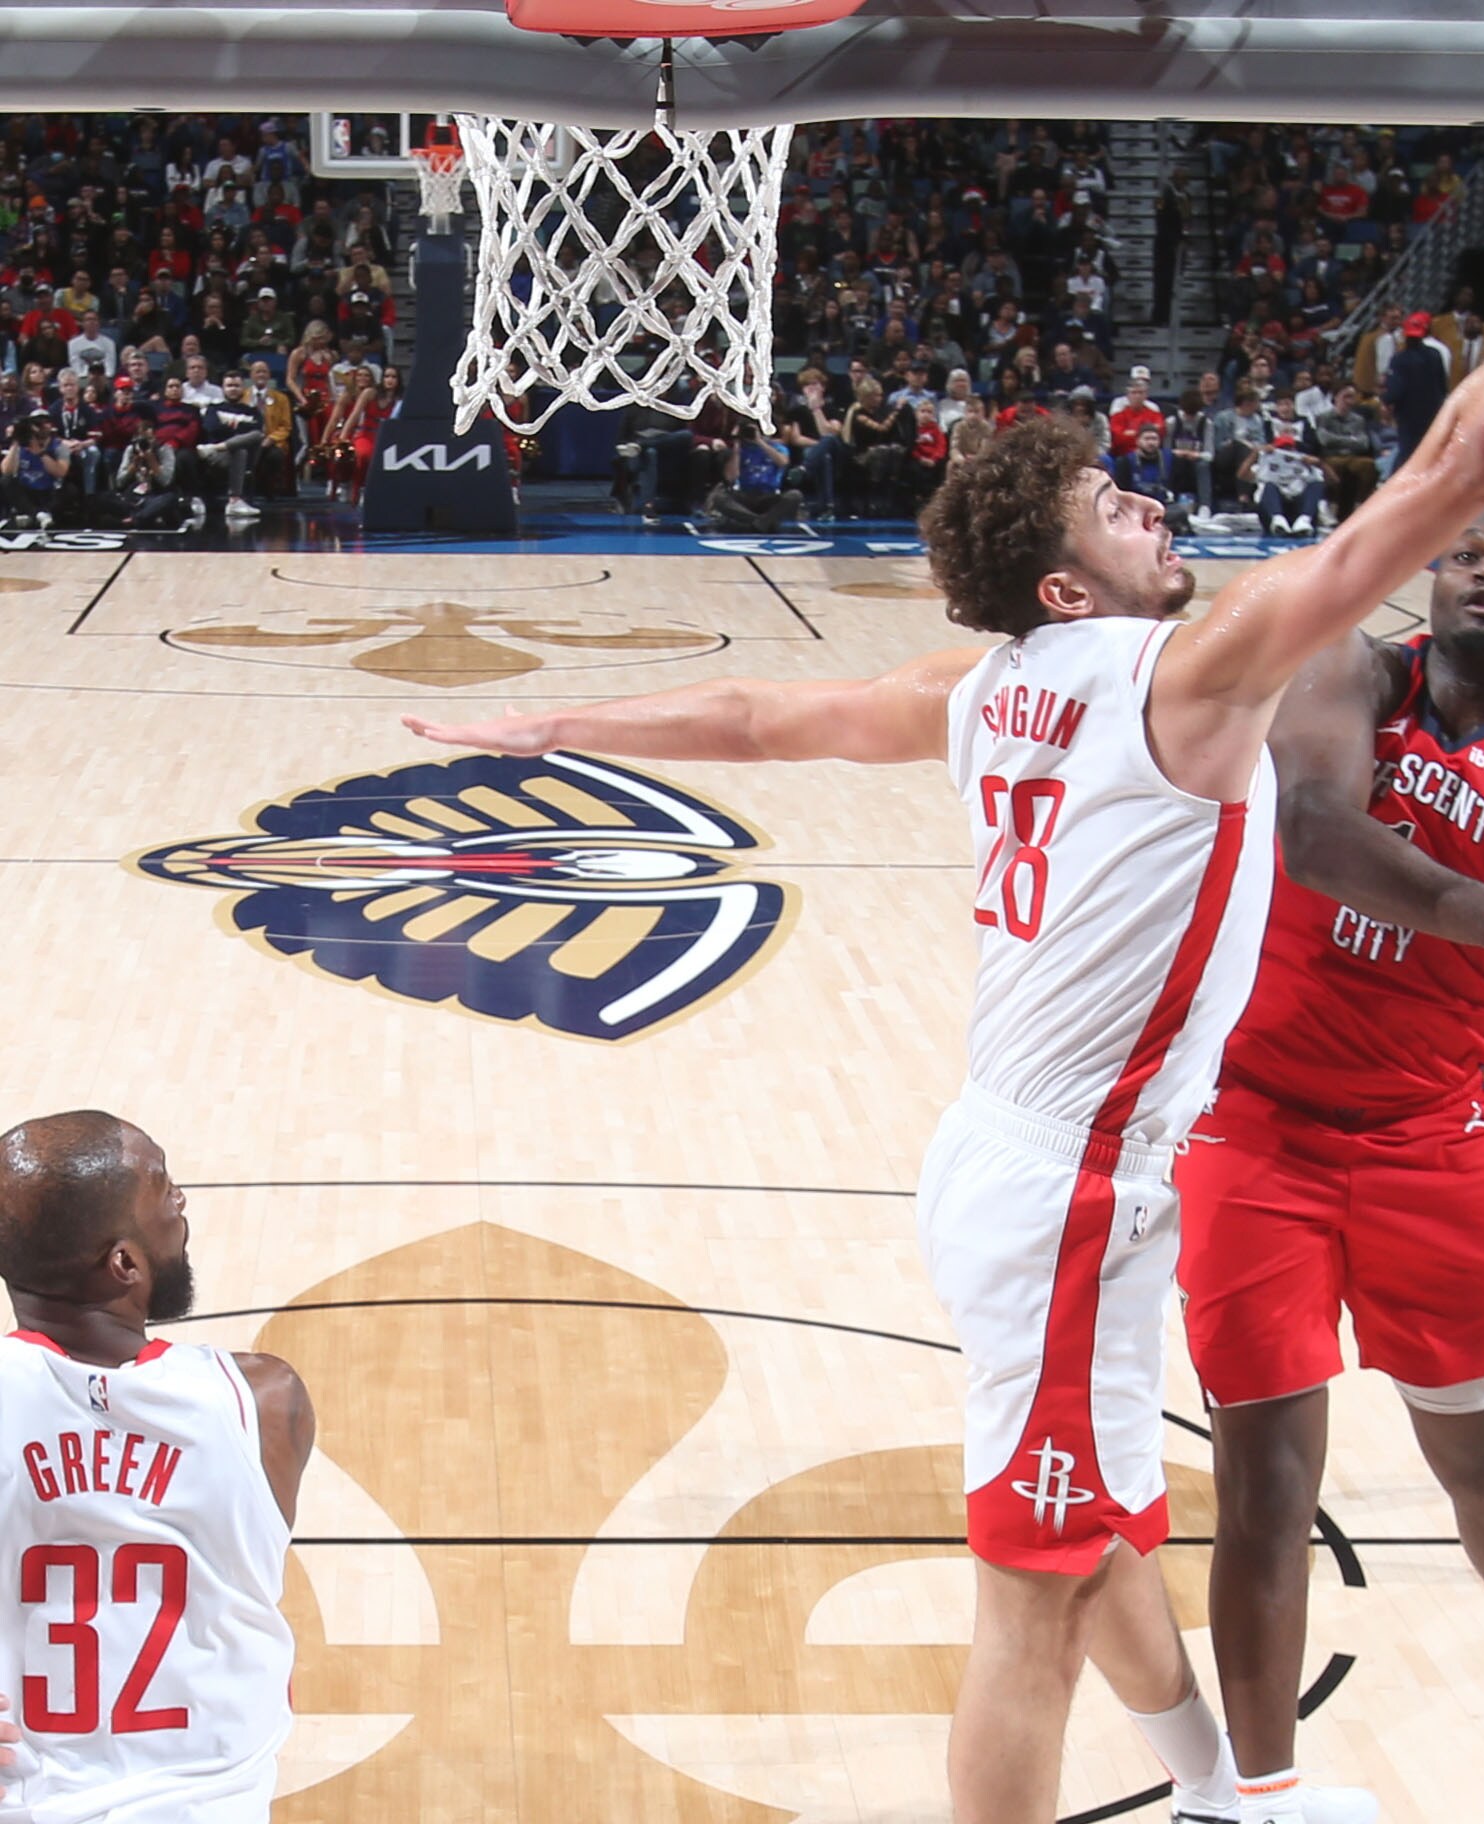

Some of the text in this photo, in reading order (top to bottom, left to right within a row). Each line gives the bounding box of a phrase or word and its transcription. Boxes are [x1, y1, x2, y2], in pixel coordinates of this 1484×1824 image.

[383, 443, 491, 471] KIA
[974, 775, 1066, 943] 28
[1332, 903, 1415, 963] CITY
[23, 1430, 182, 1506] GREEN
[21, 1543, 188, 1734] 32
